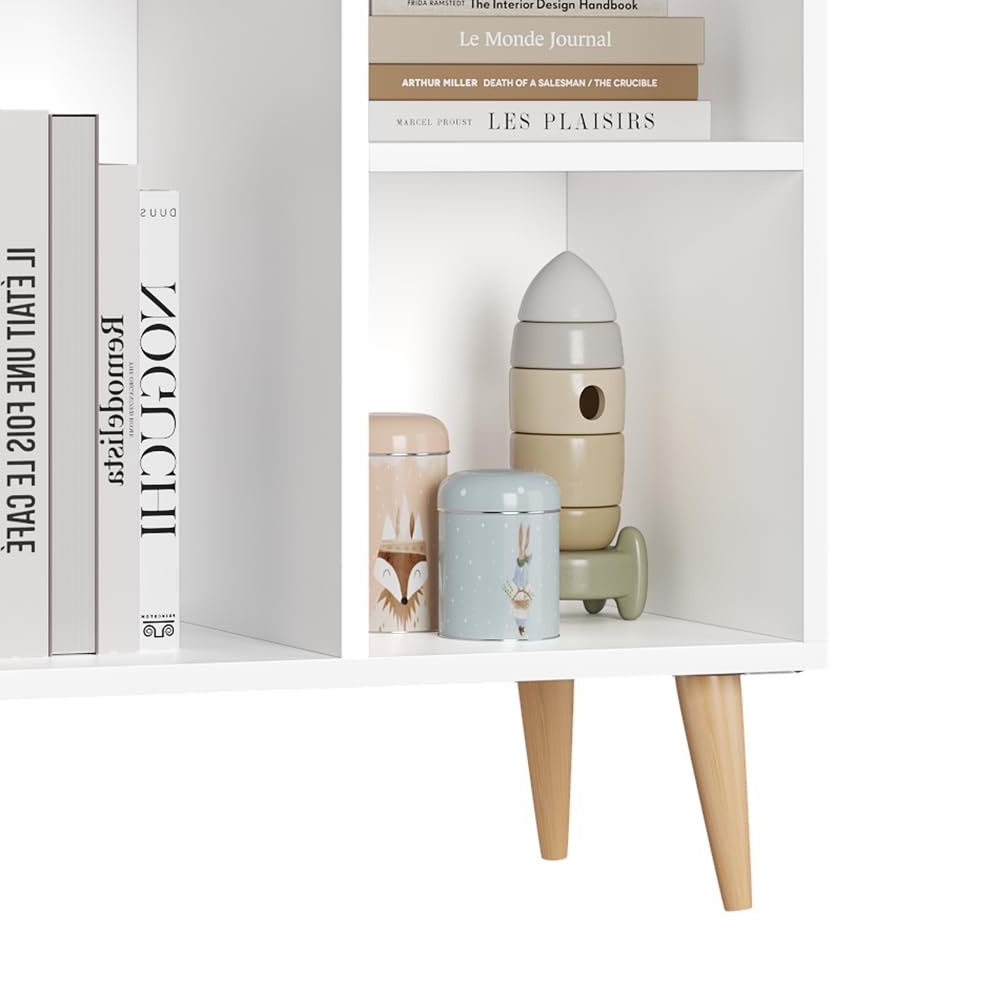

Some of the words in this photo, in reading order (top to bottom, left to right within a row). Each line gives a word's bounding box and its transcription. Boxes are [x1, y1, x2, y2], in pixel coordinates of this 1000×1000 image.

[407, 0, 427, 7] FRIDA
[536, 0, 575, 13] Design
[579, 0, 638, 10] Handbook
[460, 31, 479, 46] Le
[485, 31, 544, 47] Monde
[549, 31, 611, 49] Journal
[402, 78, 440, 87] ARTHUR
[443, 78, 478, 87] MILLER
[484, 78, 513, 87] DEATH
[515, 78, 528, 87] OF
[538, 78, 585, 87] SALESMAN
[594, 78, 611, 87] THE
[614, 78, 657, 87] CRUCIBLE
[397, 118, 432, 126] MARCEL
[437, 118, 472, 126] PROUST
[488, 113, 530, 130] LES
[544, 113, 656, 130] PLAISIRS
